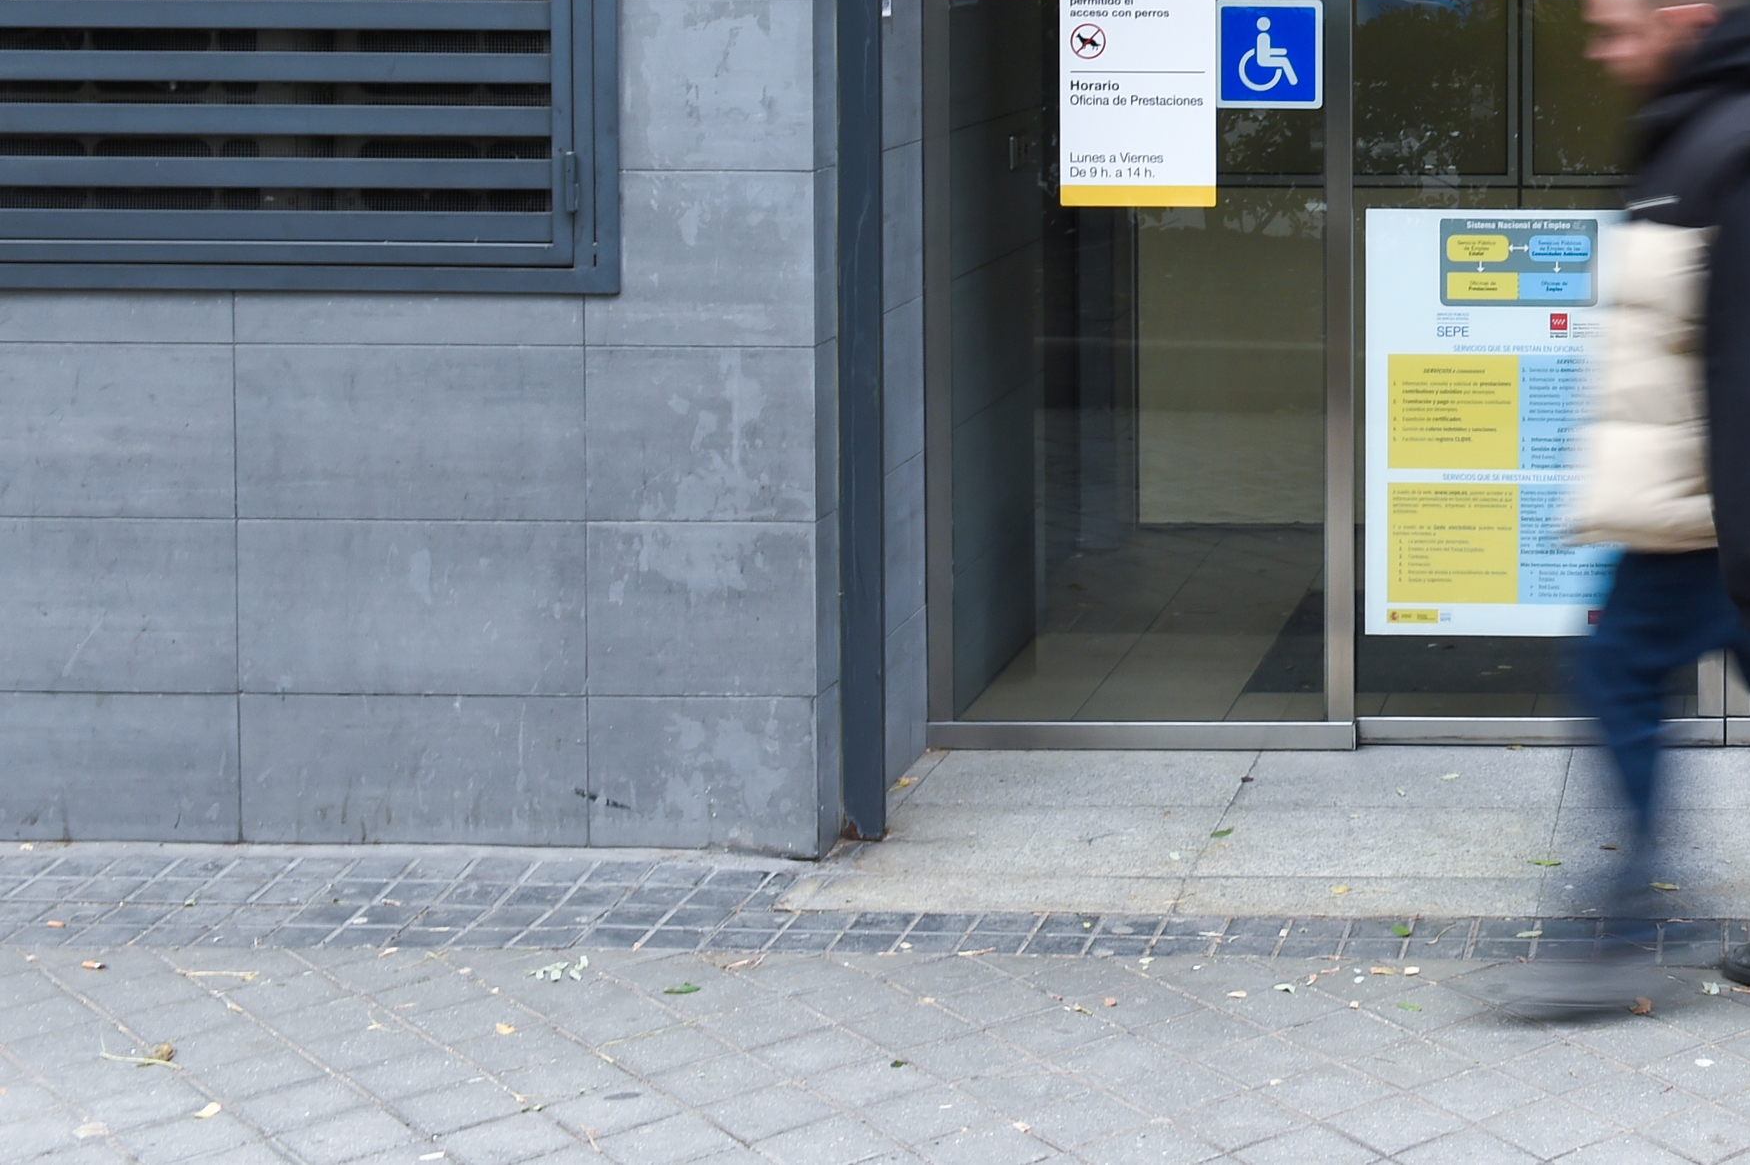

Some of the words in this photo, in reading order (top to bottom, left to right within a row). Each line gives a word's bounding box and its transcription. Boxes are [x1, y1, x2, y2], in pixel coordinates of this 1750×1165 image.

[1135, 10, 1170, 19] perros
[1070, 80, 1120, 91] Horario
[1070, 94, 1110, 106] Oficina
[1112, 94, 1127, 106] de
[1130, 95, 1204, 106] Prestaciones
[1070, 152, 1106, 163] Lunes
[1109, 155, 1116, 163] a
[1120, 152, 1164, 164] Viernes
[1070, 166, 1086, 178] De
[1090, 166, 1097, 178] 9
[1101, 167, 1111, 178] h.
[1115, 169, 1122, 178] a
[1127, 167, 1140, 178] 14
[1144, 167, 1155, 178] h.
[1466, 221, 1496, 229] Sistema
[1498, 221, 1530, 229] Nacional
[1532, 221, 1542, 229] de
[1544, 221, 1571, 230] Empleo
[1436, 326, 1469, 338] SEPE
